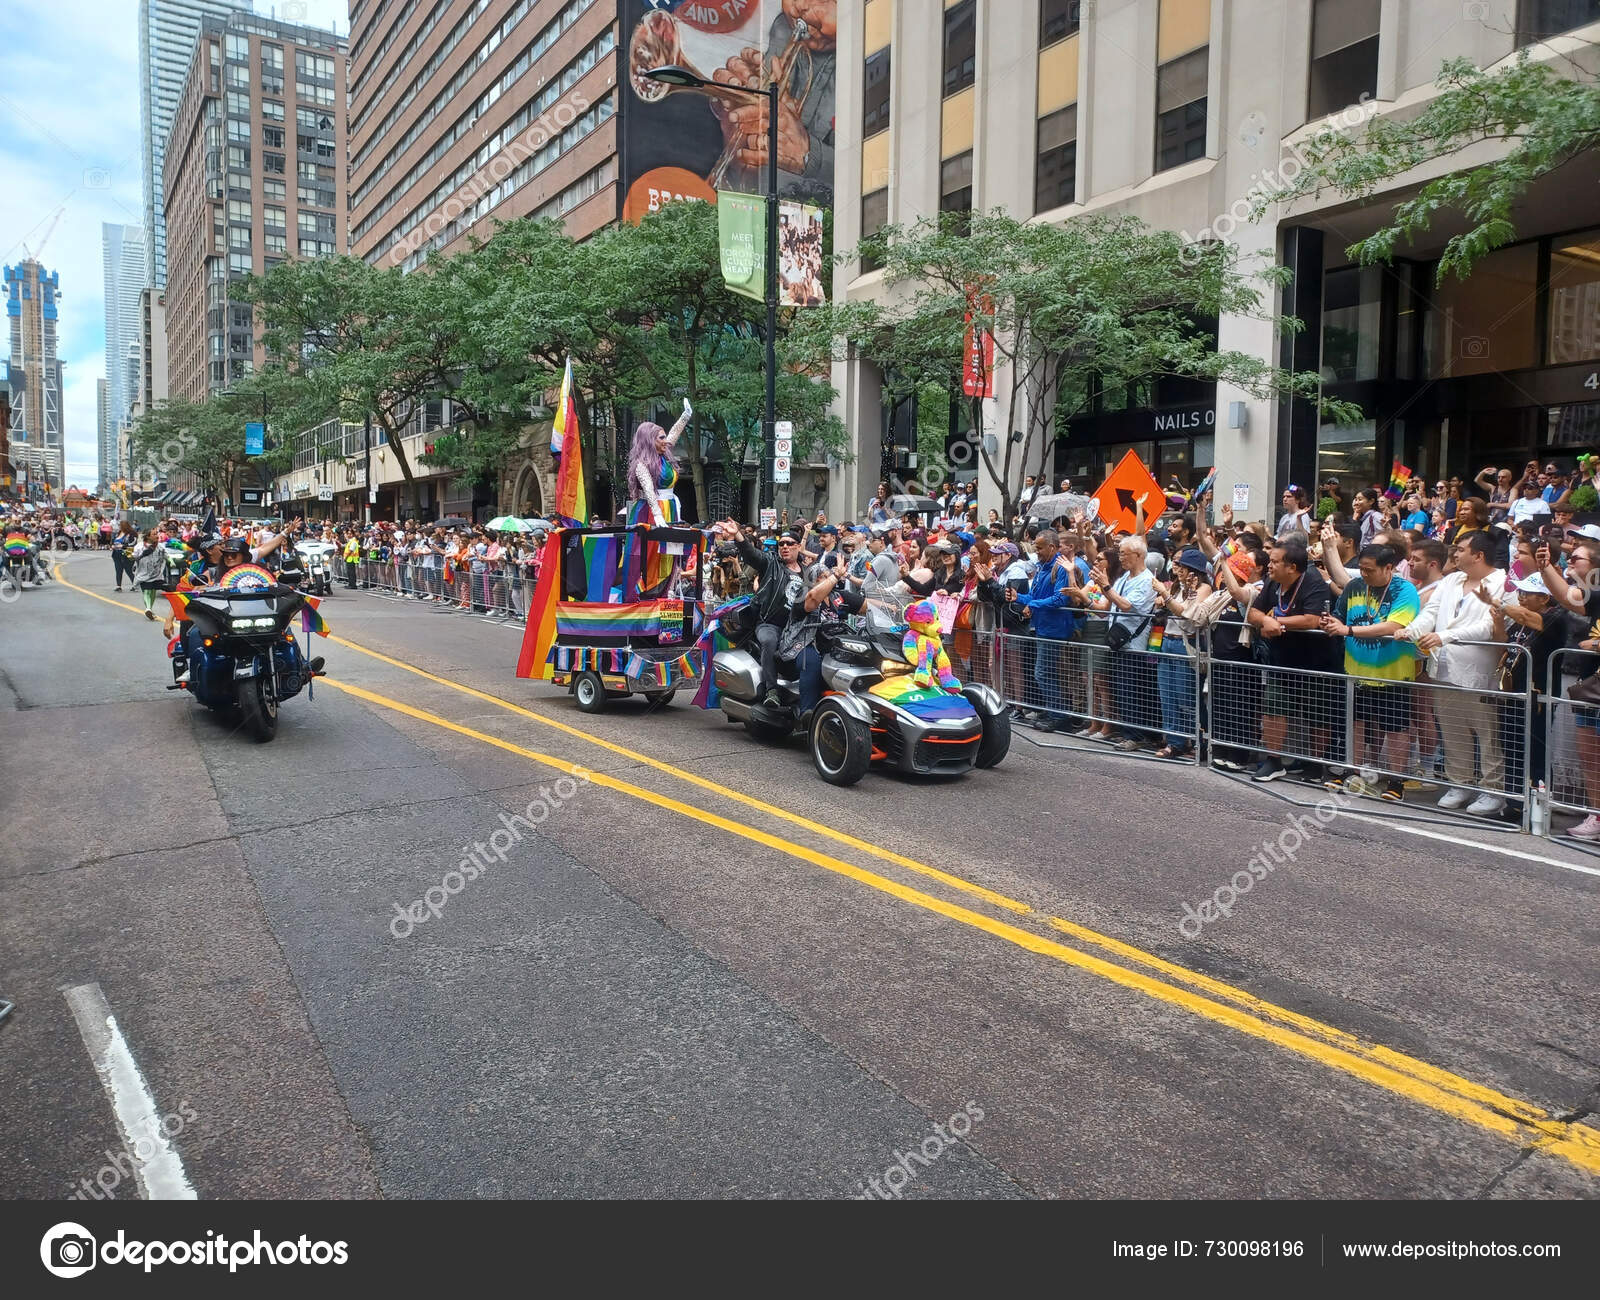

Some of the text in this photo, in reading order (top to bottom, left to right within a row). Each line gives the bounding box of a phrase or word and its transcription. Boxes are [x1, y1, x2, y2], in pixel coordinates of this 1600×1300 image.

[685, 3, 719, 25] AND
[1155, 411, 1200, 432] NAILS
[320, 490, 332, 499] 40
